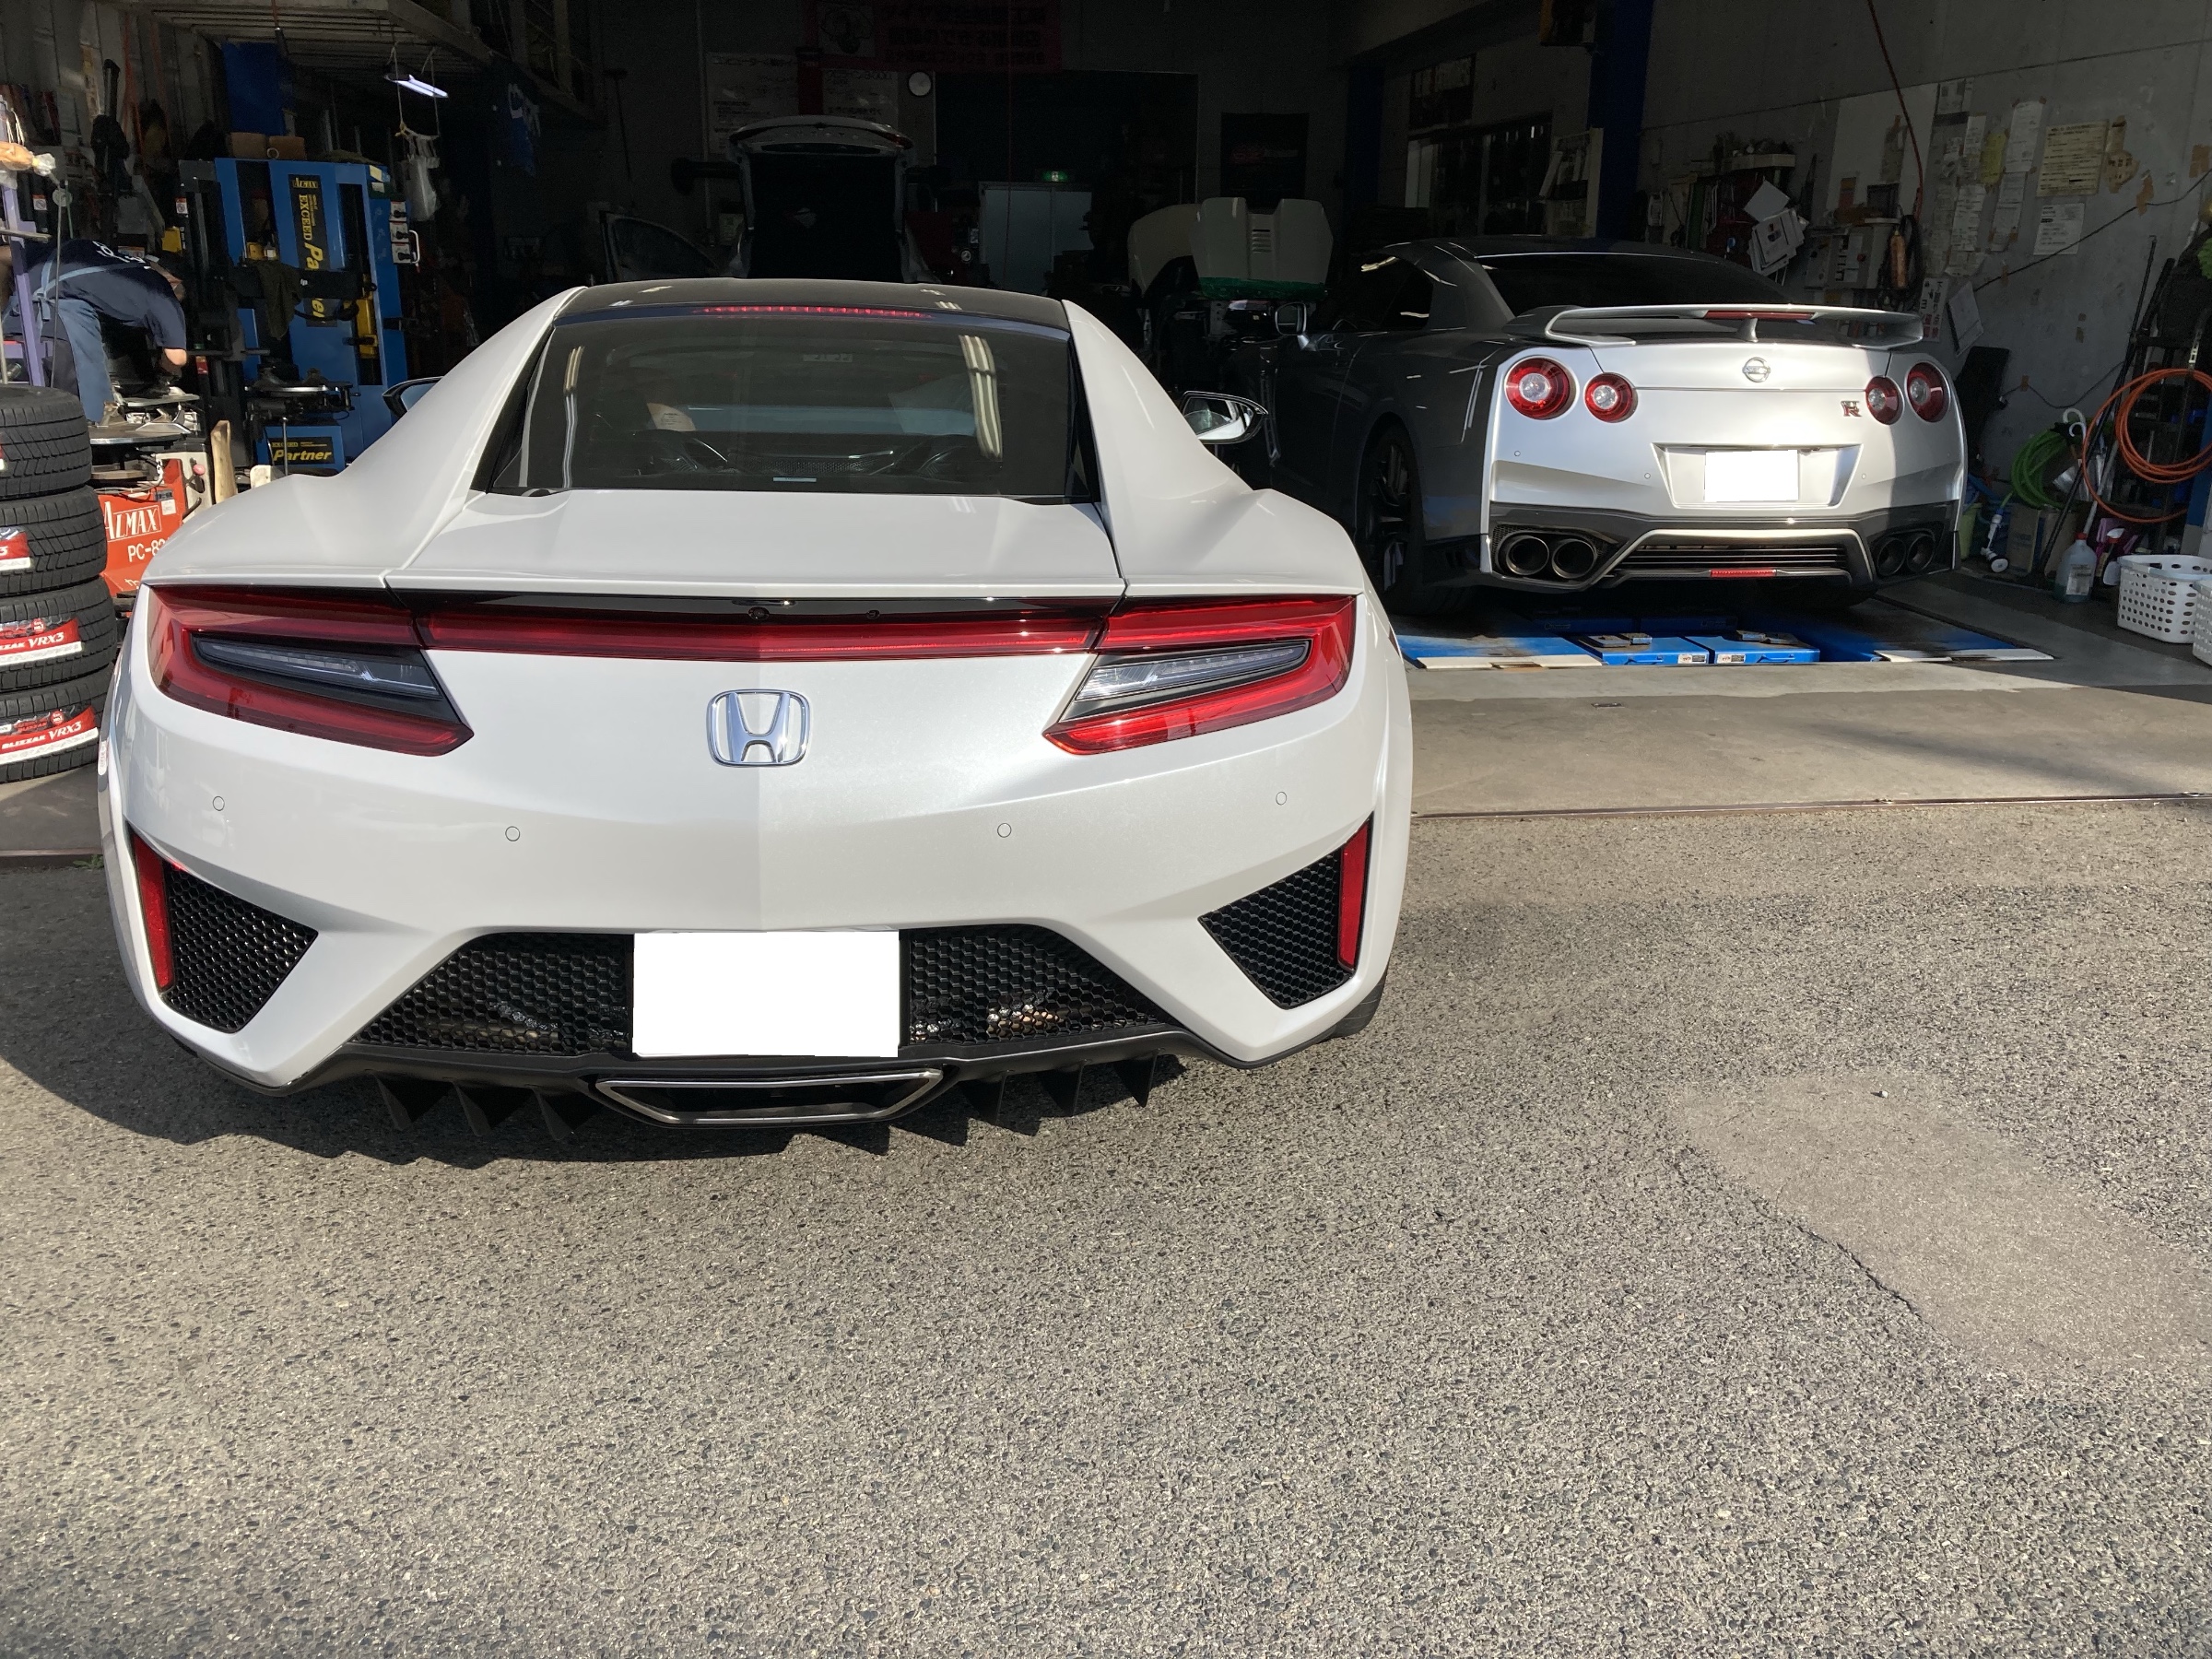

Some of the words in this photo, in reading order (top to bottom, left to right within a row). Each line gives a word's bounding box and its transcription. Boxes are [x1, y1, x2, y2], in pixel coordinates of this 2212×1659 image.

[299, 194, 313, 241] EXCEED
[273, 449, 332, 462] Partner
[104, 500, 158, 540] ALMAX
[28, 631, 65, 648] VRX3
[48, 720, 82, 740] VRX3
